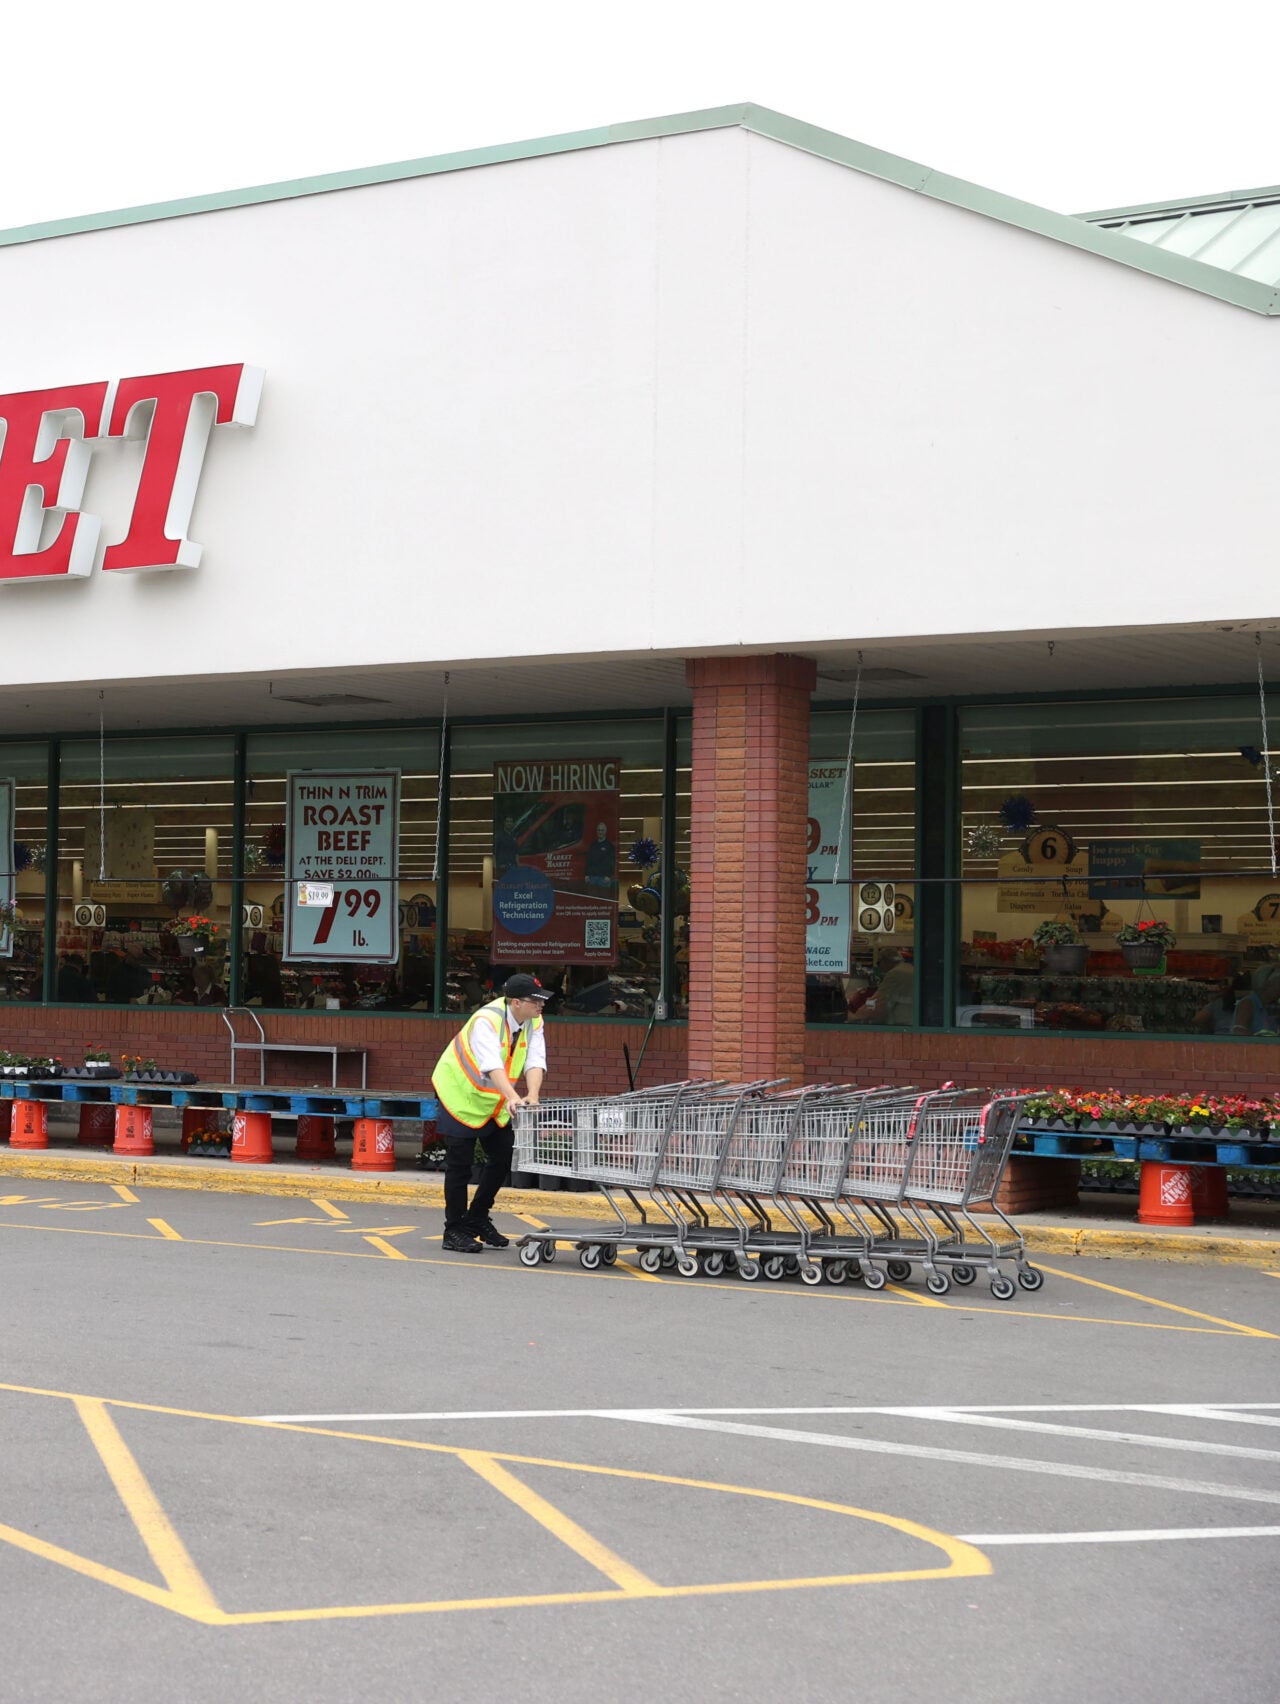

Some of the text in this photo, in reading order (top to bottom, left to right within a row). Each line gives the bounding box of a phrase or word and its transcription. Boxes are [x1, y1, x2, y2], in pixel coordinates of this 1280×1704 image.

[498, 764, 615, 792] NOW HIRING
[808, 768, 846, 778] SKET
[299, 786, 387, 800] THIN N TRIM
[304, 805, 384, 826] ROAST
[318, 830, 372, 851] BEEF
[1041, 837, 1057, 859] 6
[299, 856, 386, 865] AT THE DELI DEPT.
[304, 870, 334, 879] SAVE
[500, 902, 548, 910] Refrigeration
[1010, 903, 1035, 911] Diapers
[81, 910, 87, 921] 6
[503, 911, 544, 919] Technicians
